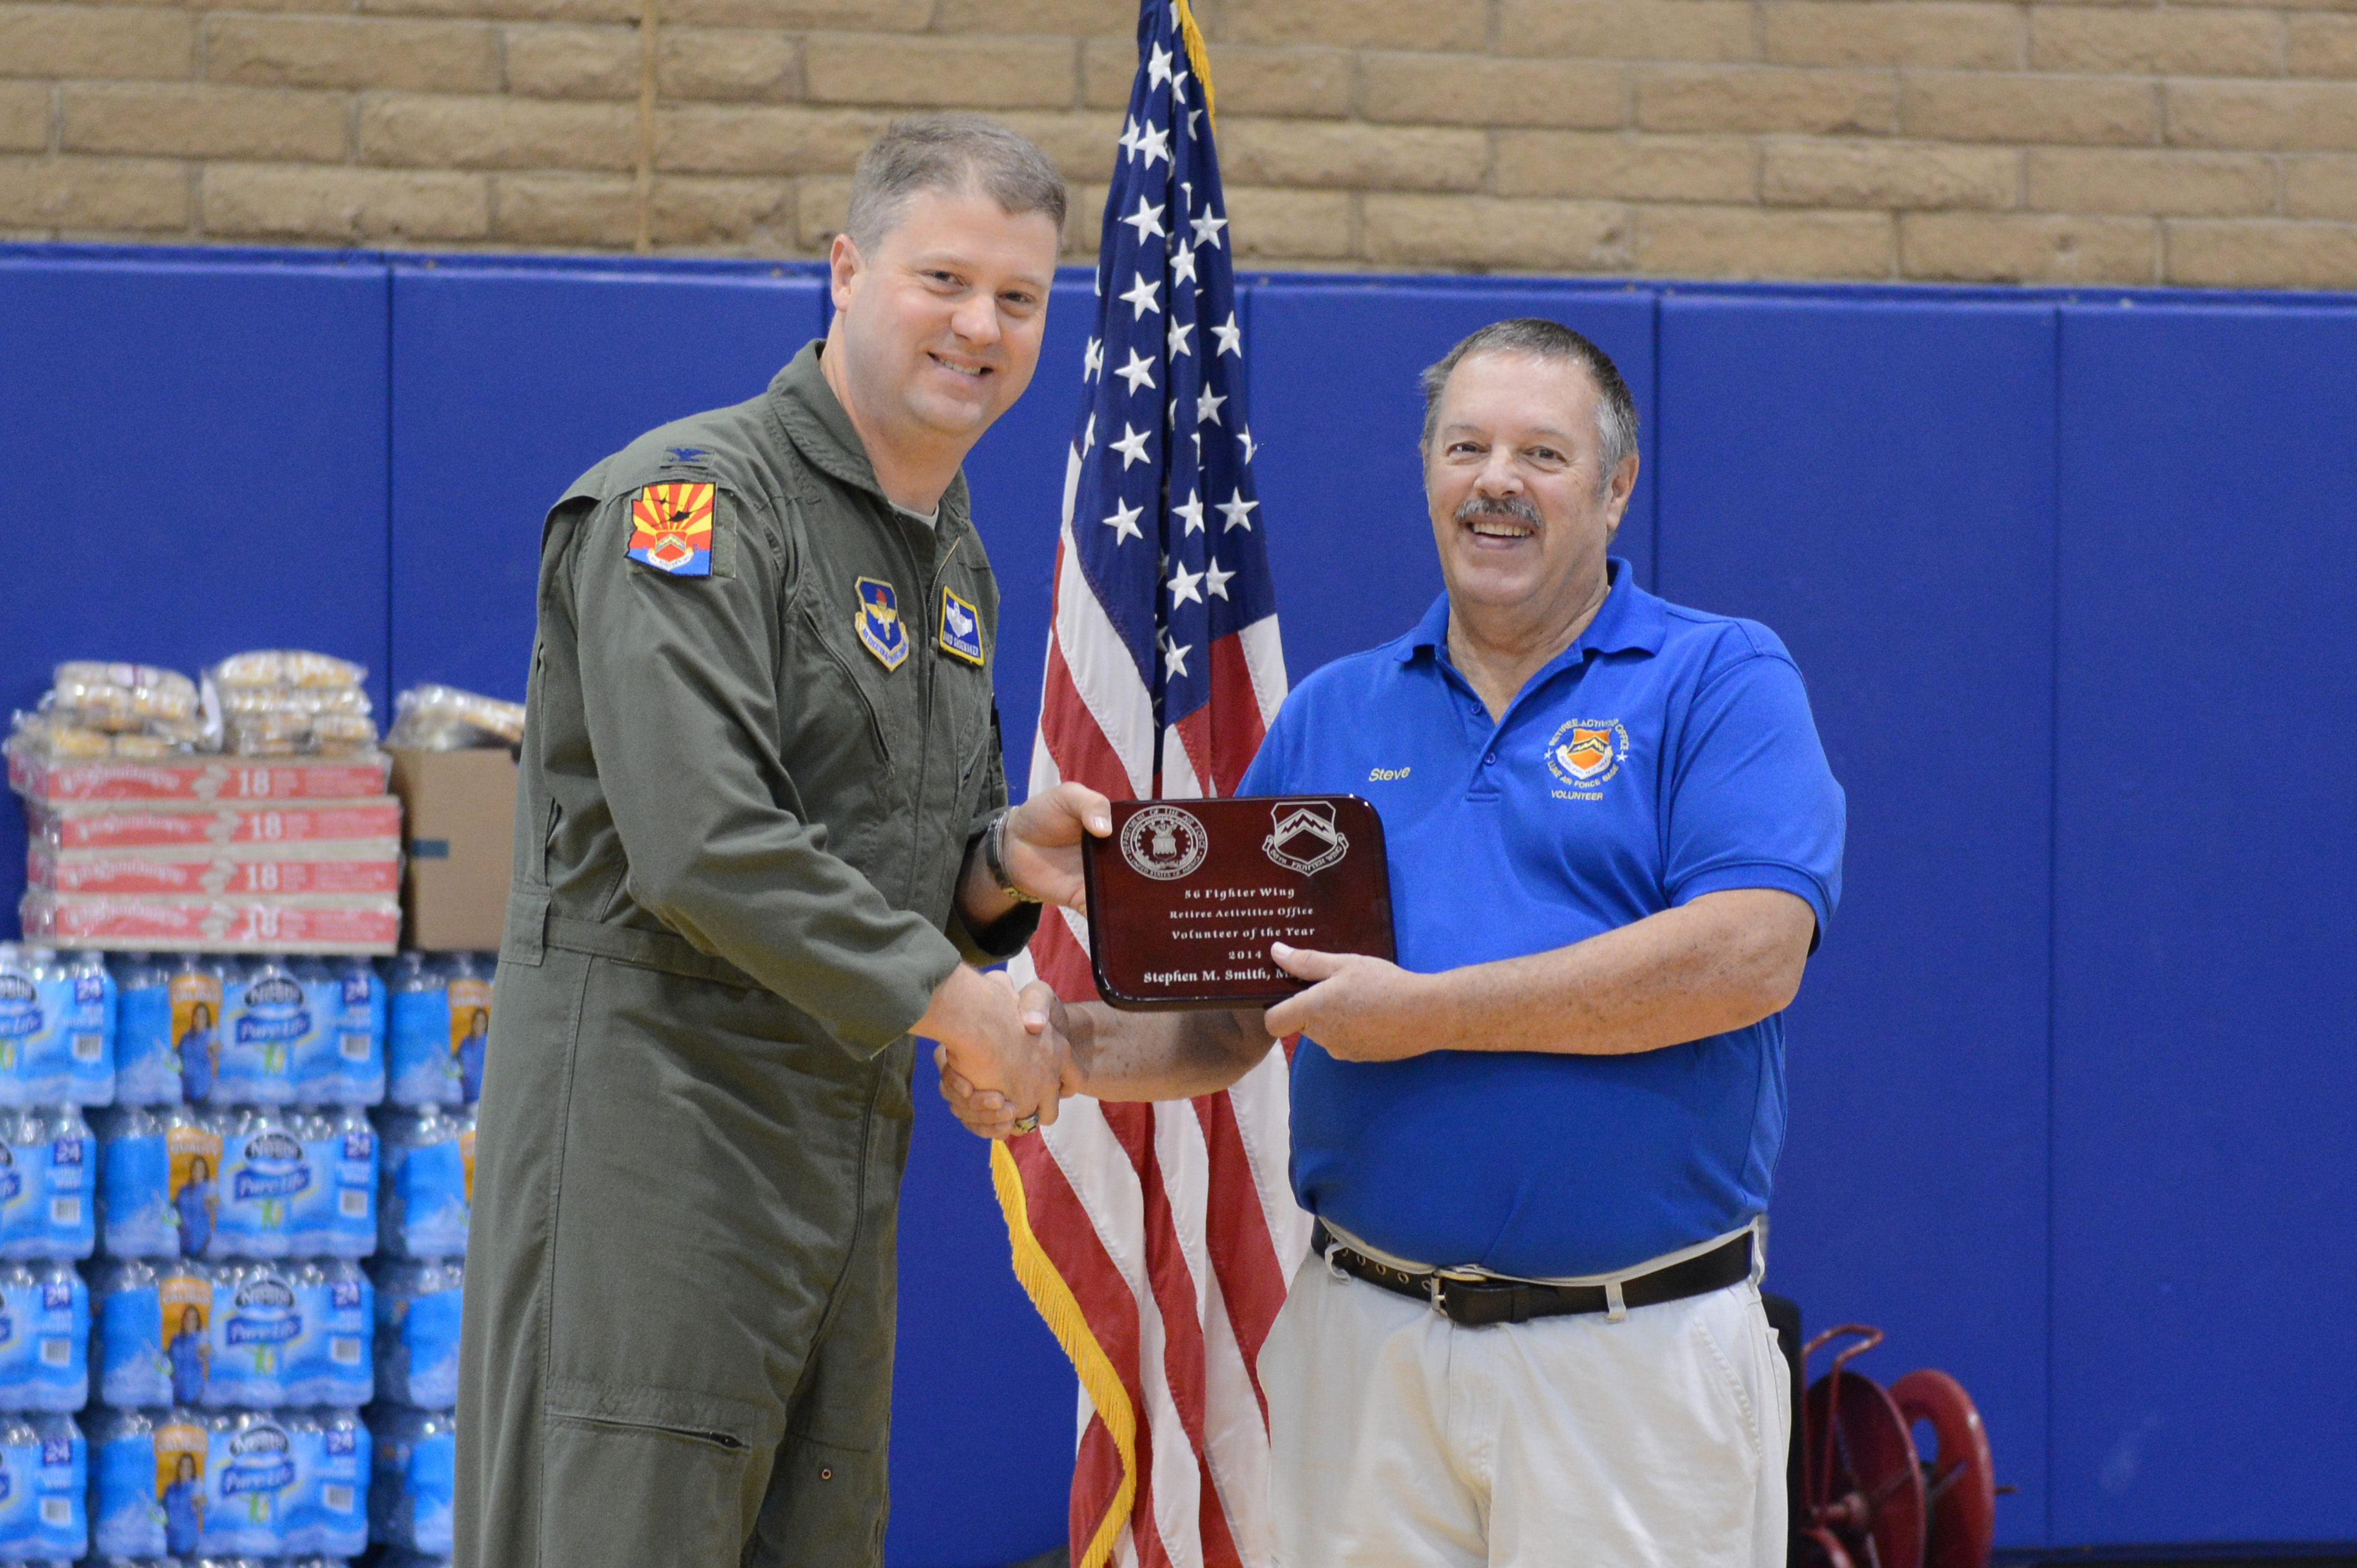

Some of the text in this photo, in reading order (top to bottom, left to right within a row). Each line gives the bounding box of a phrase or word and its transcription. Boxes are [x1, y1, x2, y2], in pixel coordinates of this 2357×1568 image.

[1368, 767, 1411, 782] Steve
[1560, 776, 1573, 786] AIR
[1574, 778, 1601, 788] FORCE
[239, 770, 270, 796] 18
[1551, 789, 1603, 801] VOLUNTEER
[252, 812, 281, 840] 18
[1183, 815, 1195, 824] AIR
[1195, 826, 1205, 849] FORCE
[1291, 858, 1325, 871] FIGHTER
[1326, 845, 1342, 862] WING
[248, 864, 277, 890] 18
[1185, 887, 1295, 901] 56 Fighter Wing
[1170, 906, 1314, 919] Retiree Activities Office
[248, 910, 277, 937] 18
[1172, 927, 1315, 940] Volunteer of the Year
[1228, 950, 1262, 960] 2014
[1144, 970, 1198, 986] Stephen
[1202, 970, 1220, 981] M.
[1225, 968, 1270, 981] Smith,
